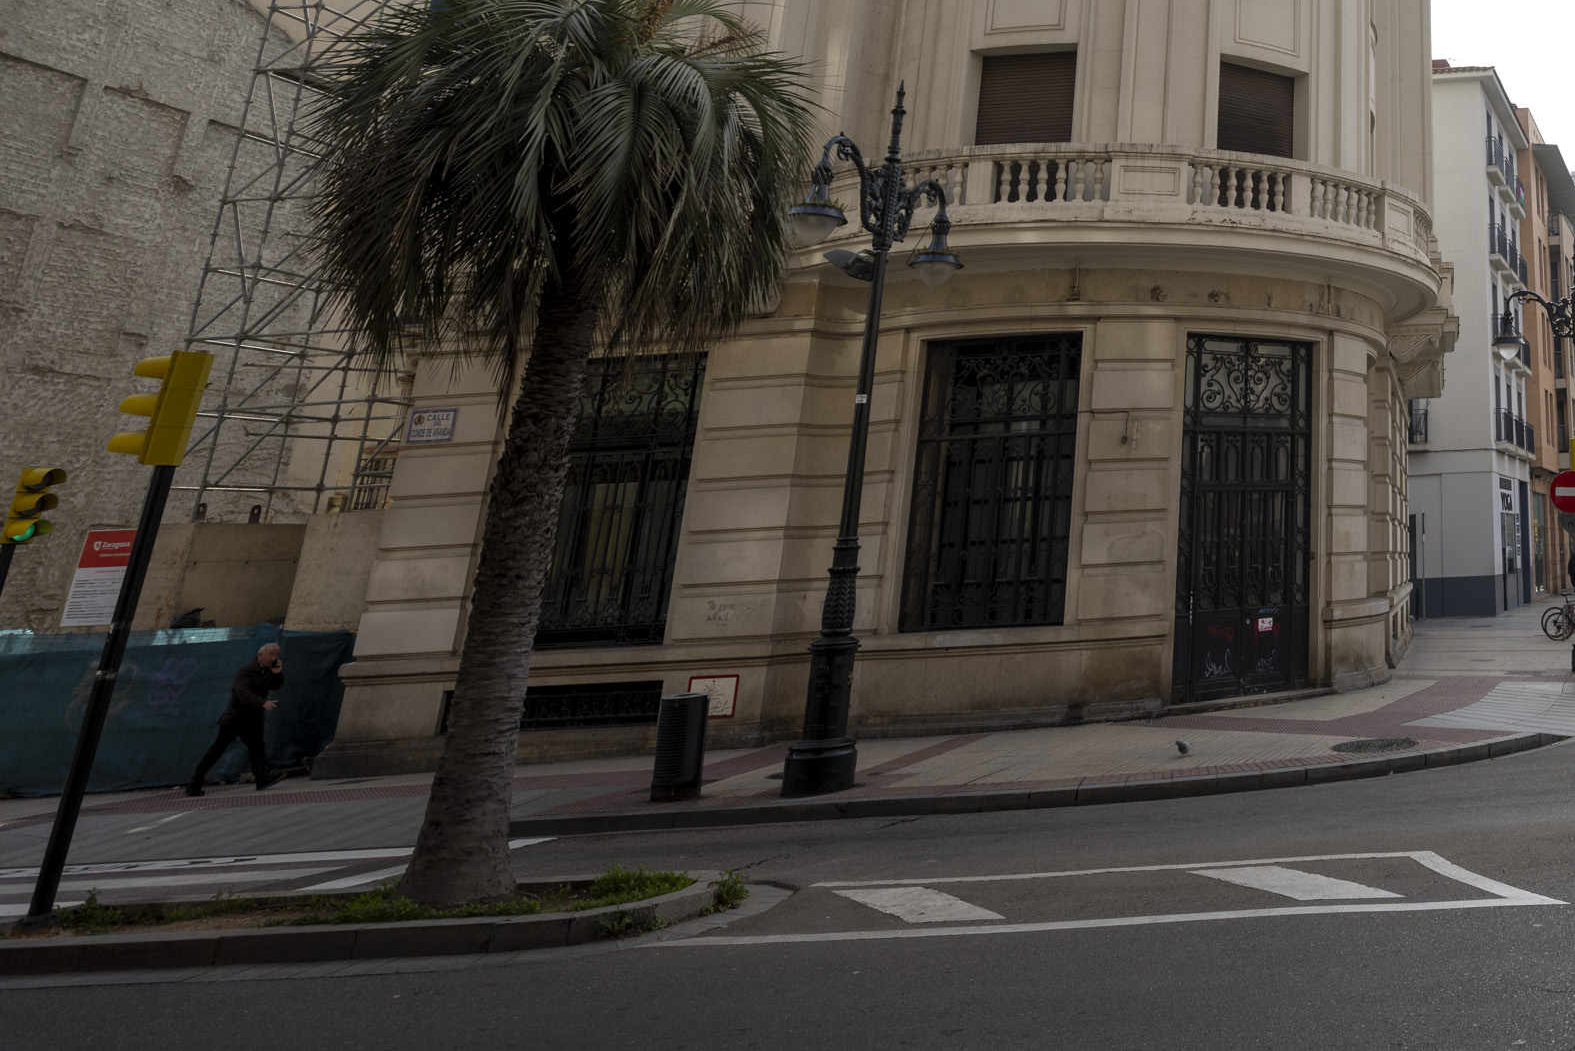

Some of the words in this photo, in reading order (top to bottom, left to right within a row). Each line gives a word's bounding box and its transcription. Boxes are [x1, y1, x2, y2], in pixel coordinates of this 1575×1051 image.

[427, 413, 450, 421] CALLE
[1500, 491, 1514, 511] YOGA
[102, 541, 131, 550] Zaragoza
